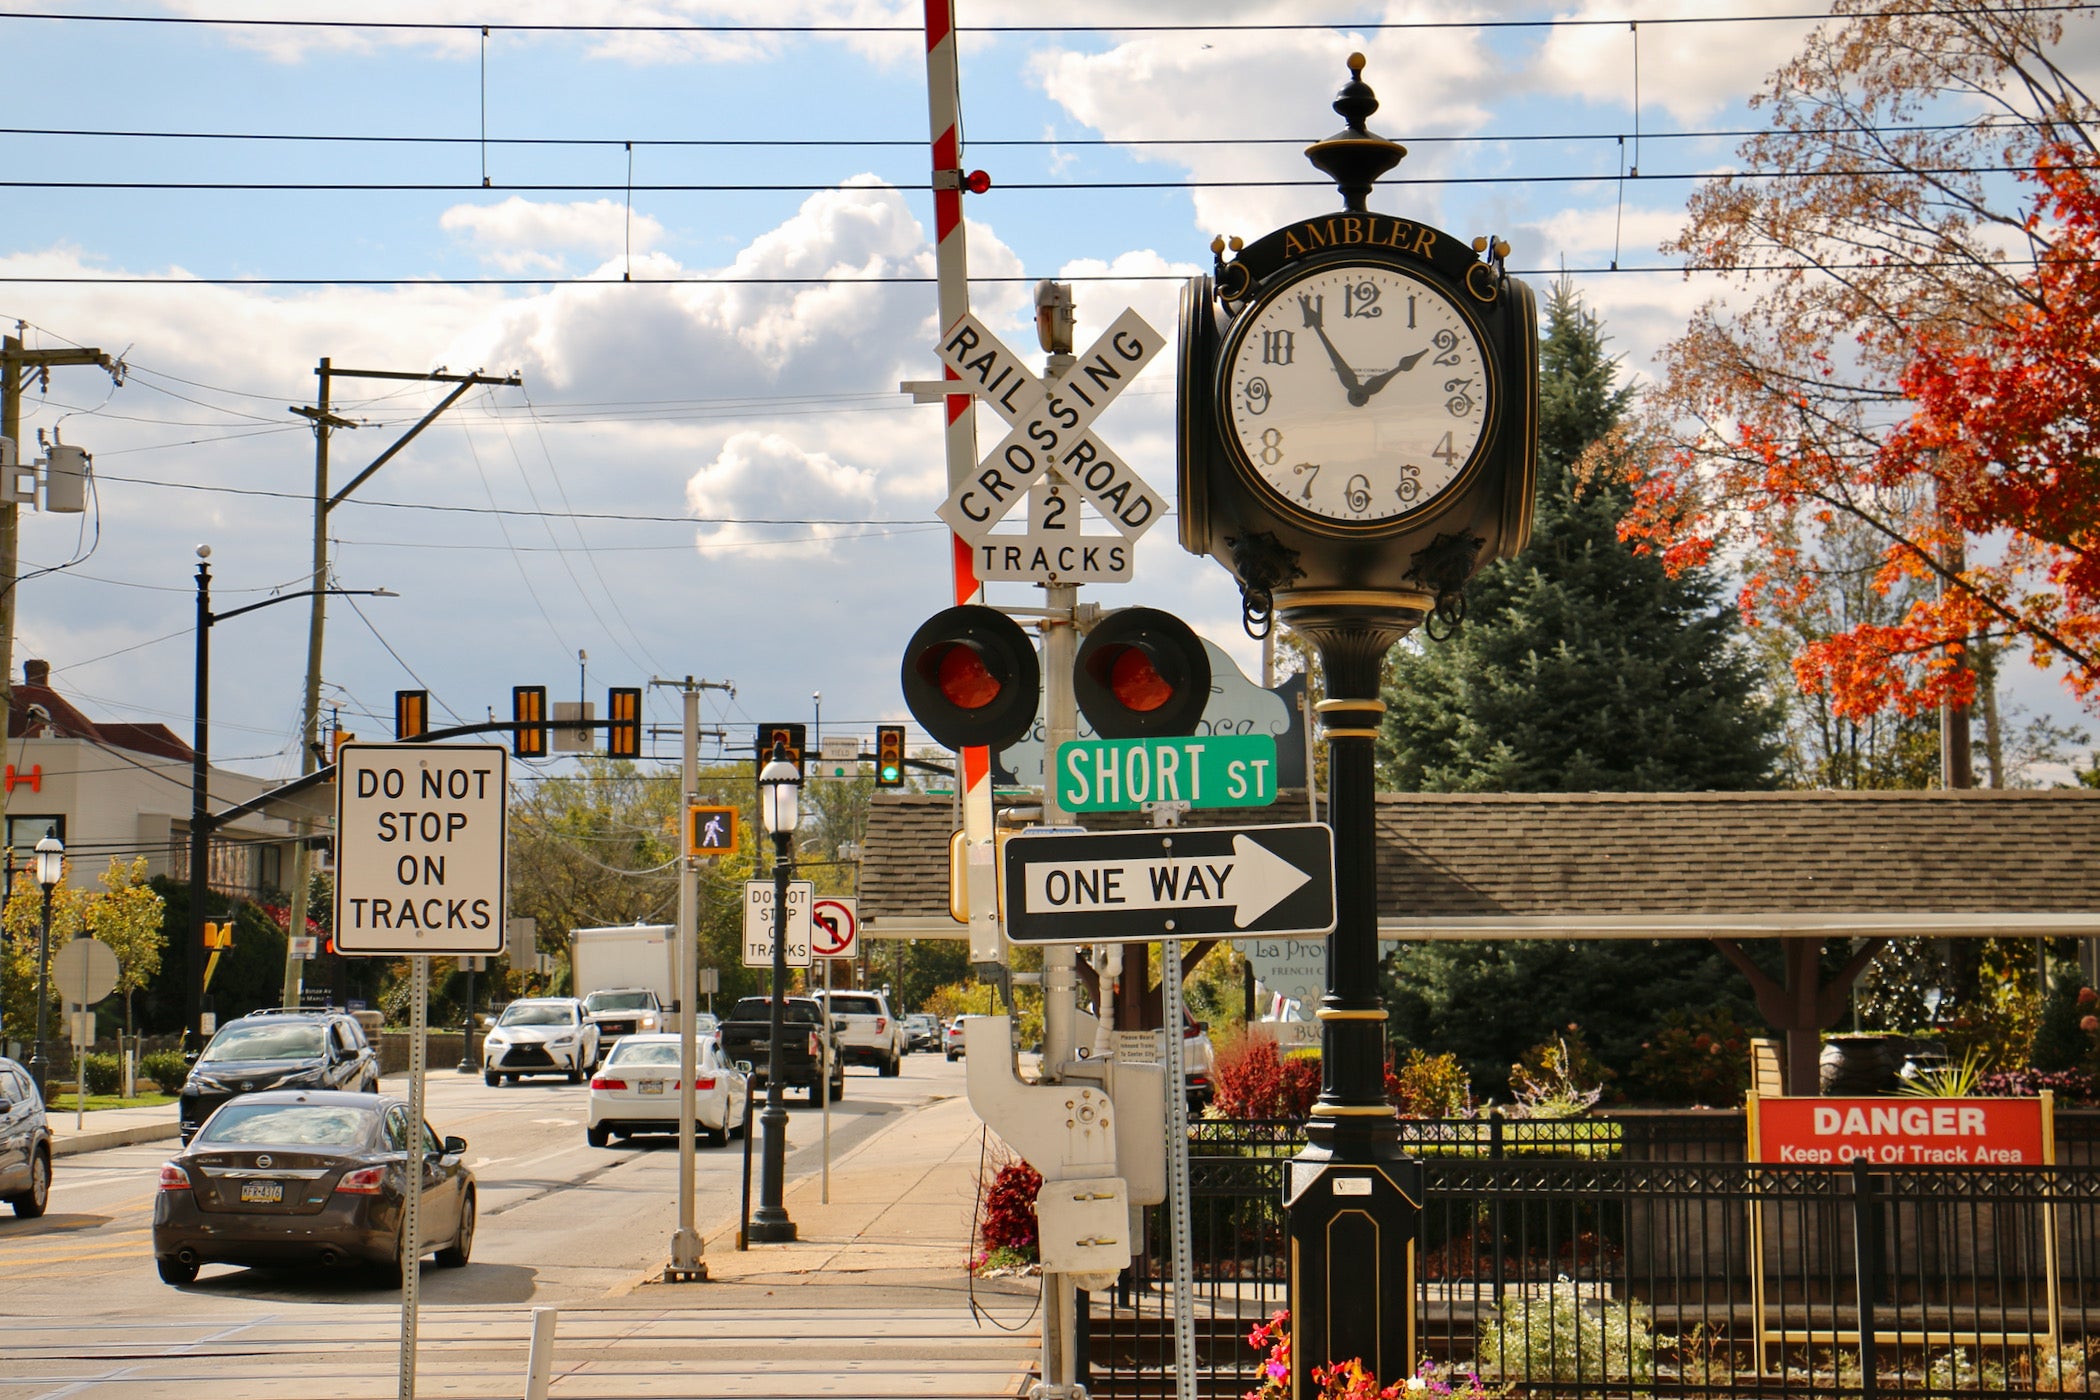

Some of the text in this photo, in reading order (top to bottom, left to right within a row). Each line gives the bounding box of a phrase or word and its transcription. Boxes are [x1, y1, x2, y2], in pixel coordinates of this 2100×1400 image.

[1284, 217, 1438, 259] AMBLER
[1344, 281, 1382, 318] 12
[1407, 295, 1416, 329] 1
[1262, 329, 1295, 366] 10
[1431, 328, 1461, 366] 2
[1244, 376, 1272, 415] 9
[1444, 378, 1475, 417] 3
[946, 326, 1153, 527] RAIL ROAD
[960, 331, 1144, 522] CROSSING
[1260, 428, 1284, 465] 8
[1432, 430, 1459, 467] 4
[1293, 462, 1320, 500] 7
[1344, 474, 1372, 513] 6
[1395, 464, 1422, 502] 5
[1043, 496, 1066, 529] 2
[982, 546, 1125, 571] TRACKS
[358, 768, 491, 799] DO NOT
[1067, 744, 1269, 805] SHORT ST
[377, 811, 468, 842] STOP
[397, 855, 445, 885] ON
[1045, 863, 1234, 906] ONE WAY
[350, 898, 491, 930] TRACKS
[752, 890, 772, 904] DO
[760, 908, 797, 921] STP
[750, 943, 806, 957] TRAKS
[1255, 940, 1279, 958] La
[1271, 966, 1314, 976] FRENCH
[1814, 1107, 1986, 1136] DANGER
[1780, 1144, 2022, 1164] Keep Out Of Track Area
